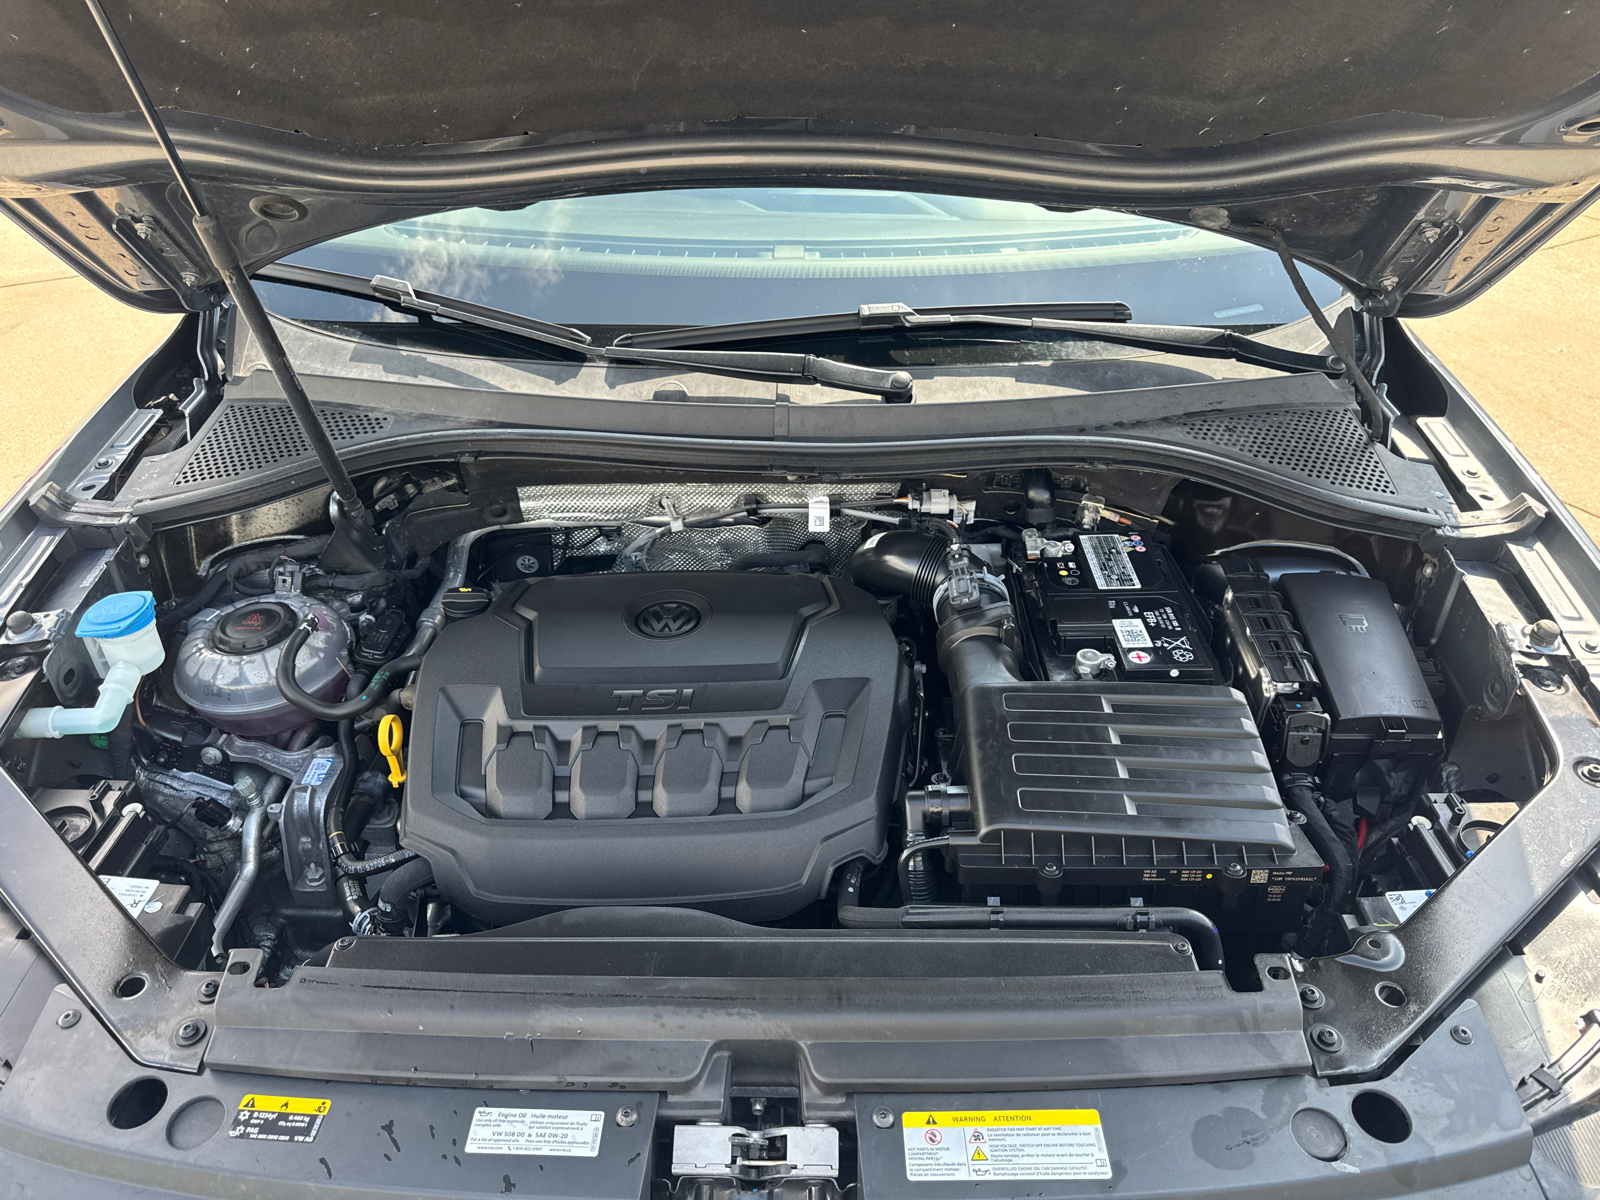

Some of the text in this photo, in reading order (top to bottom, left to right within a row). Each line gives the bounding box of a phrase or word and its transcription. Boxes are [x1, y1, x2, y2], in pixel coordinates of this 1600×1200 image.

[1143, 611, 1157, 627] EFB+
[612, 688, 694, 711] TSI
[130, 899, 141, 909] R
[252, 1111, 278, 1121] R-1234yf
[303, 1115, 310, 1123] kg
[497, 1111, 518, 1119] Engine
[951, 1115, 986, 1123] WARNING
